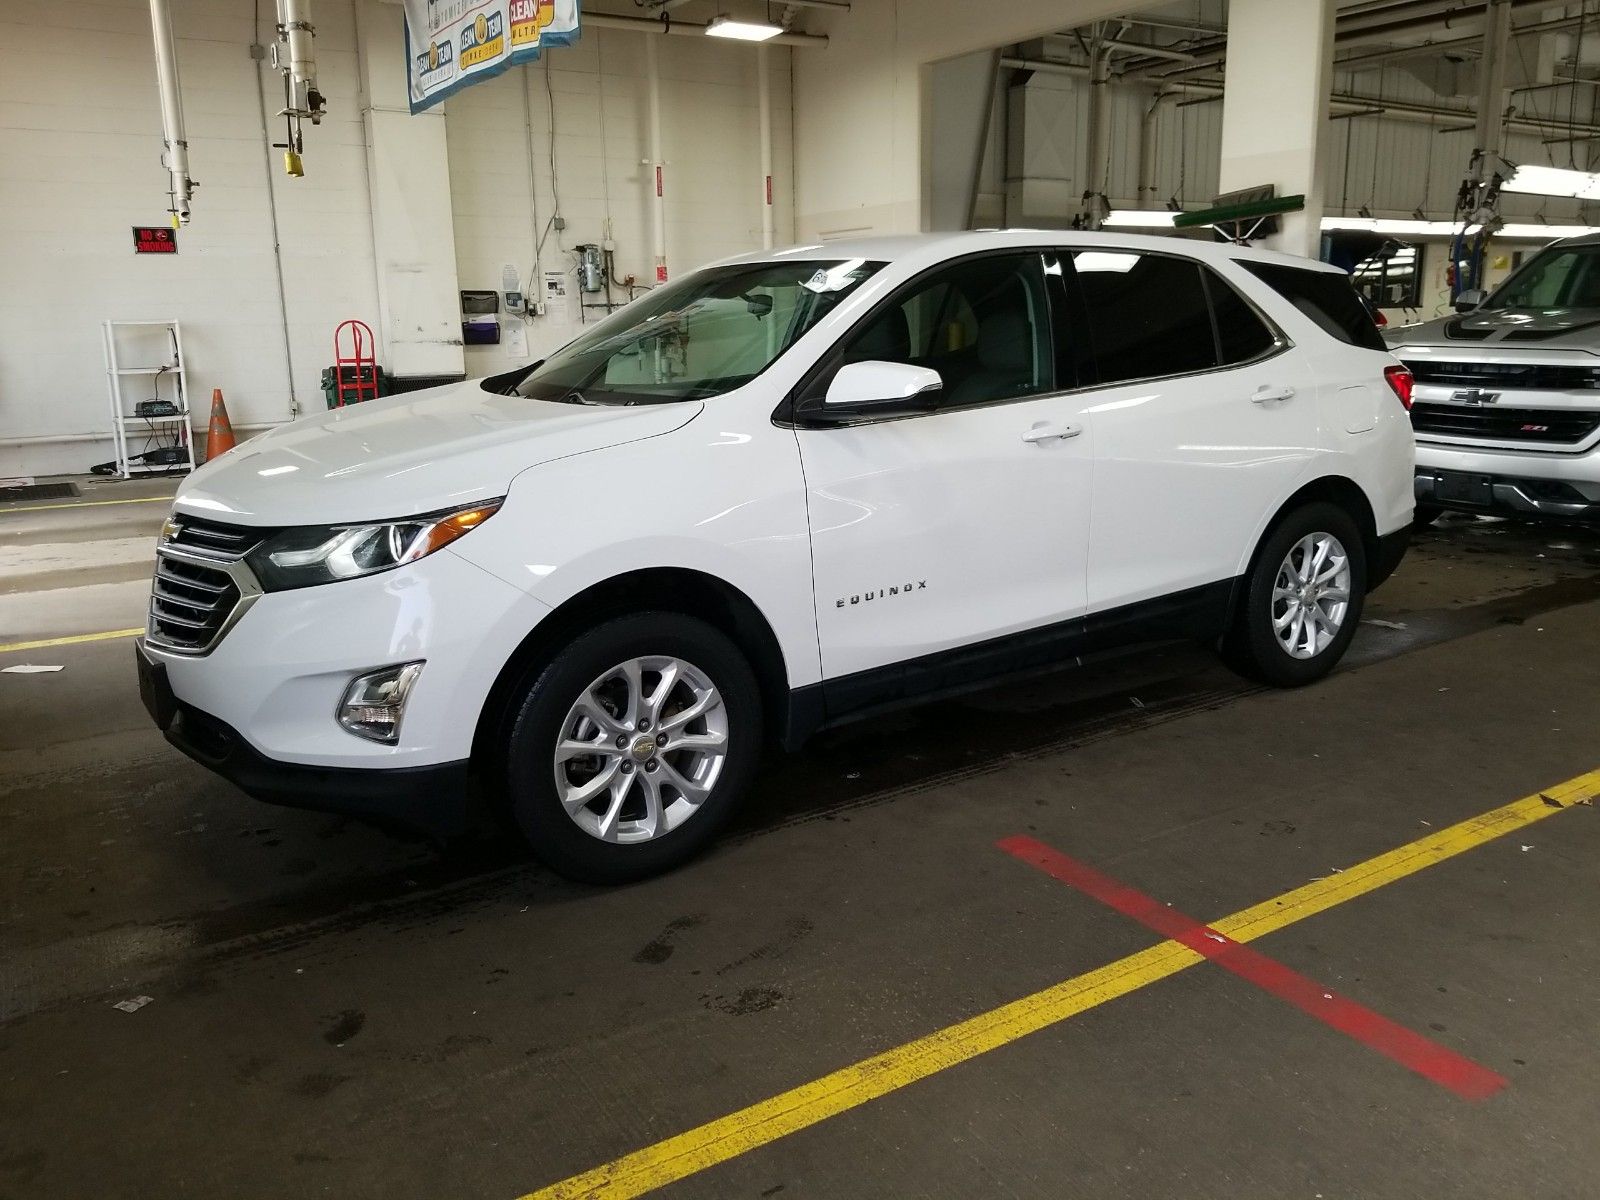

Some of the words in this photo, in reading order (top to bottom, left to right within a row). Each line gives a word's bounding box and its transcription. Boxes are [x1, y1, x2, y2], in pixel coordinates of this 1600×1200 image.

[140, 229, 153, 241] NO
[137, 241, 175, 252] SMOKING
[835, 580, 927, 608] EQUINOX
